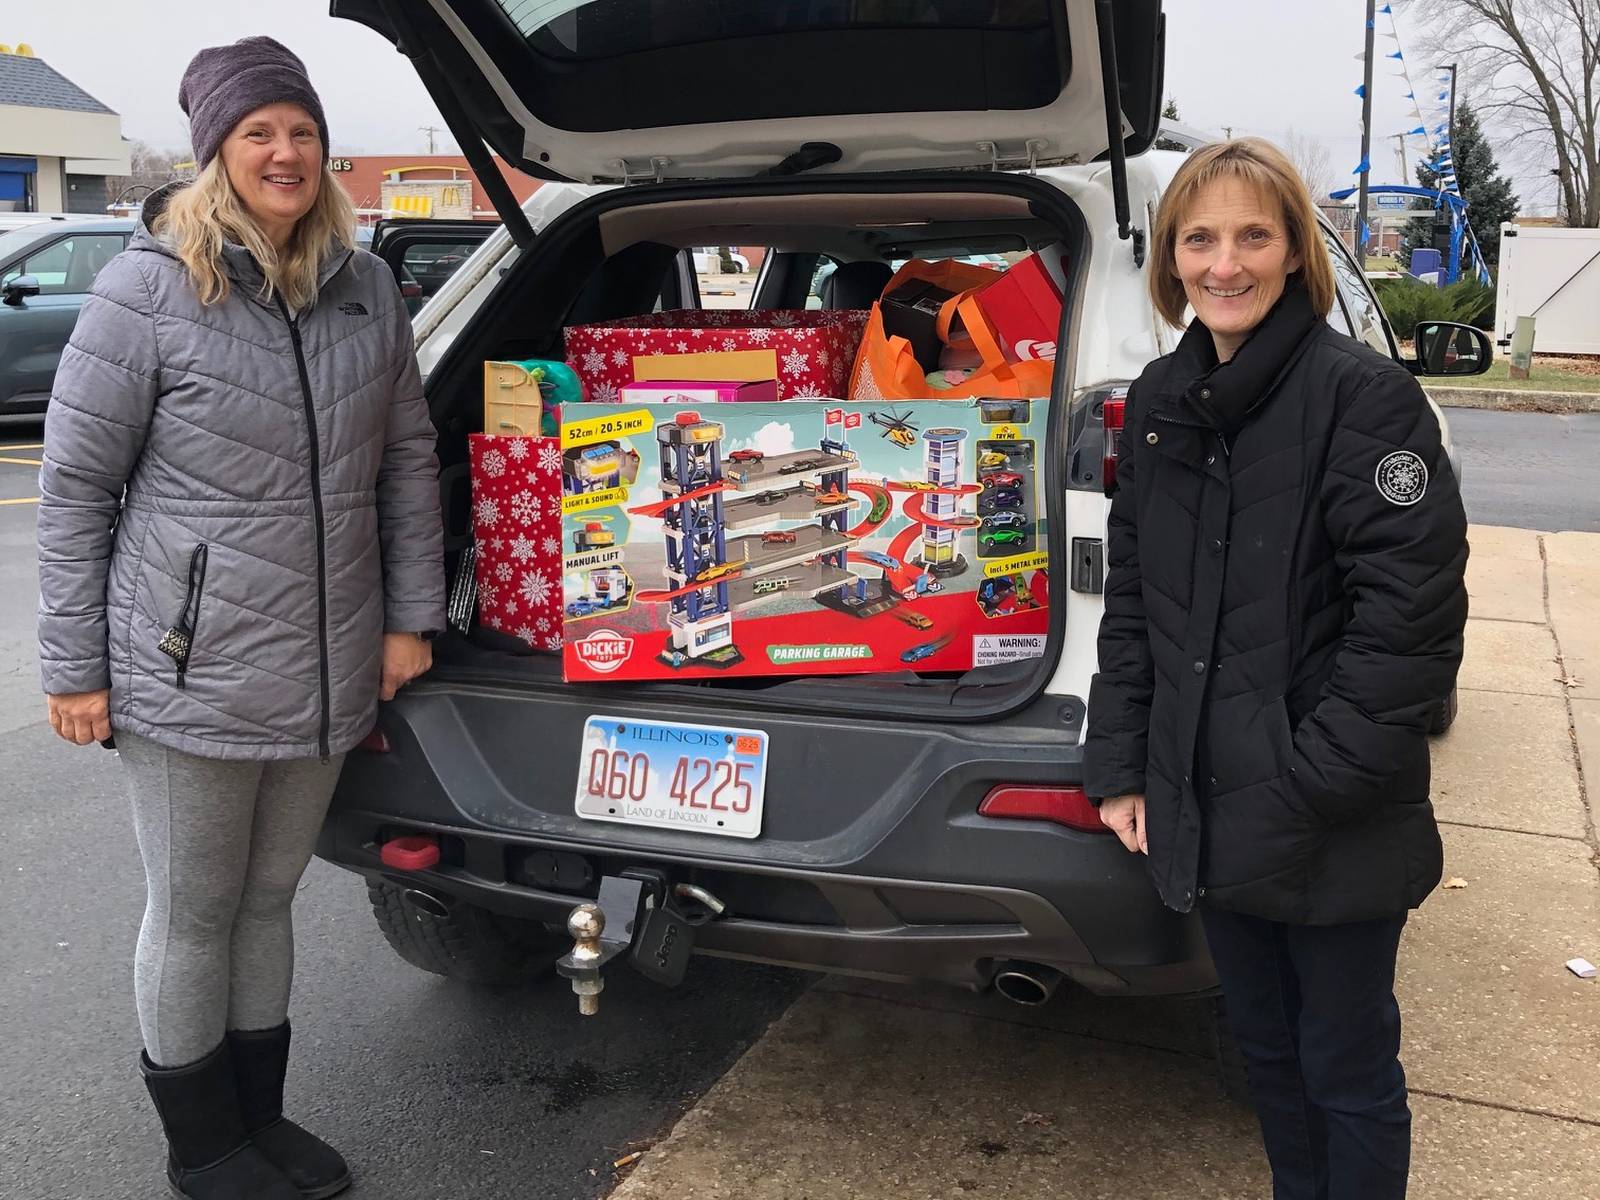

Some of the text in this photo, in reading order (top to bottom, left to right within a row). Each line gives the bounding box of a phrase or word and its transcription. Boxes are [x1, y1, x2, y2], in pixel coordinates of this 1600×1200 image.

[569, 428, 593, 440] 52cm
[600, 420, 623, 434] 20.5
[624, 418, 642, 430] INCH
[565, 493, 614, 509] LIGHT & SOUND
[566, 551, 620, 569] MANUAL LIFT
[1010, 559, 1031, 570] METAL
[998, 638, 1041, 648] WARNING:
[773, 646, 865, 660] PARKING GARAGE
[631, 727, 720, 747] ILLINOIS
[587, 748, 754, 813] Q60 4225
